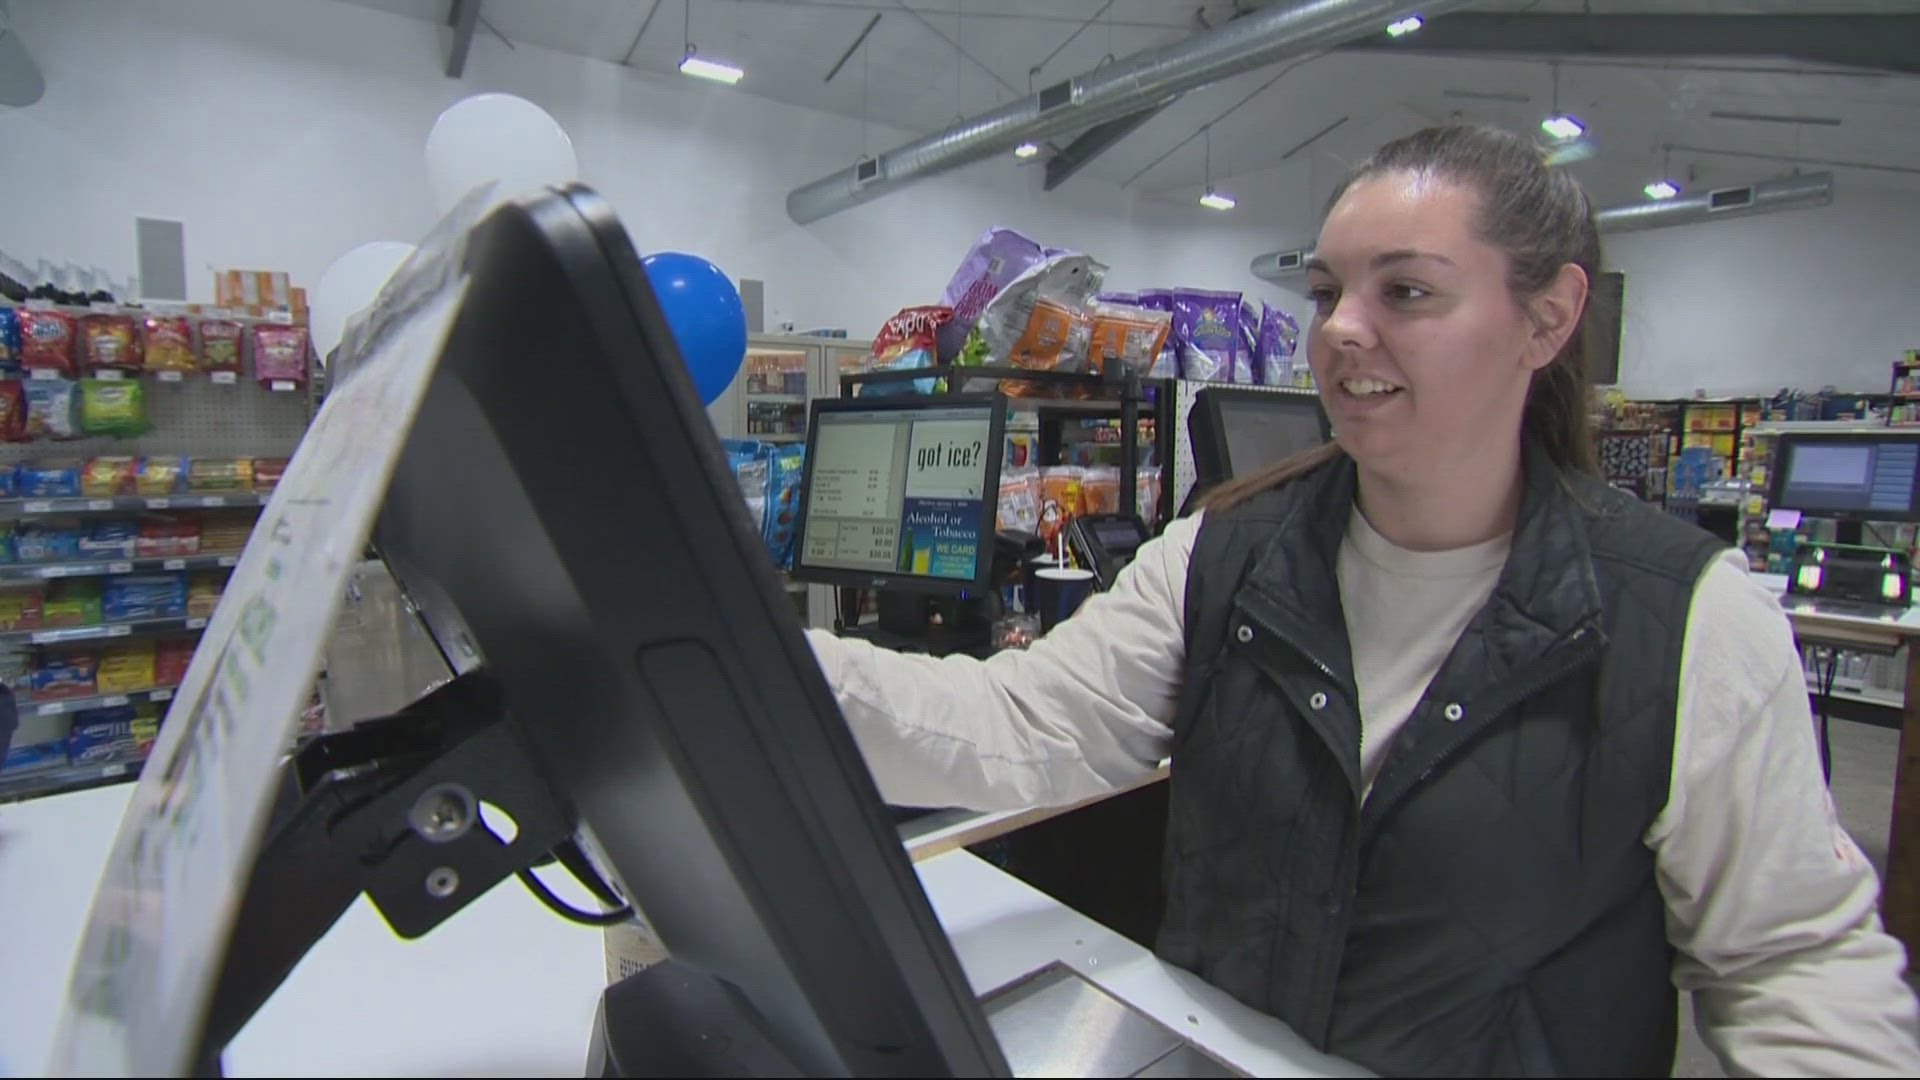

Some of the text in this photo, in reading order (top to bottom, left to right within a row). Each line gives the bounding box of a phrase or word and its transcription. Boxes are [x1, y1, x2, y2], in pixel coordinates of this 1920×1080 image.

[917, 440, 981, 472] got ice?
[906, 512, 963, 525] Alcohol or
[932, 525, 976, 539] Tobacco
[936, 543, 976, 555] WE CARD
